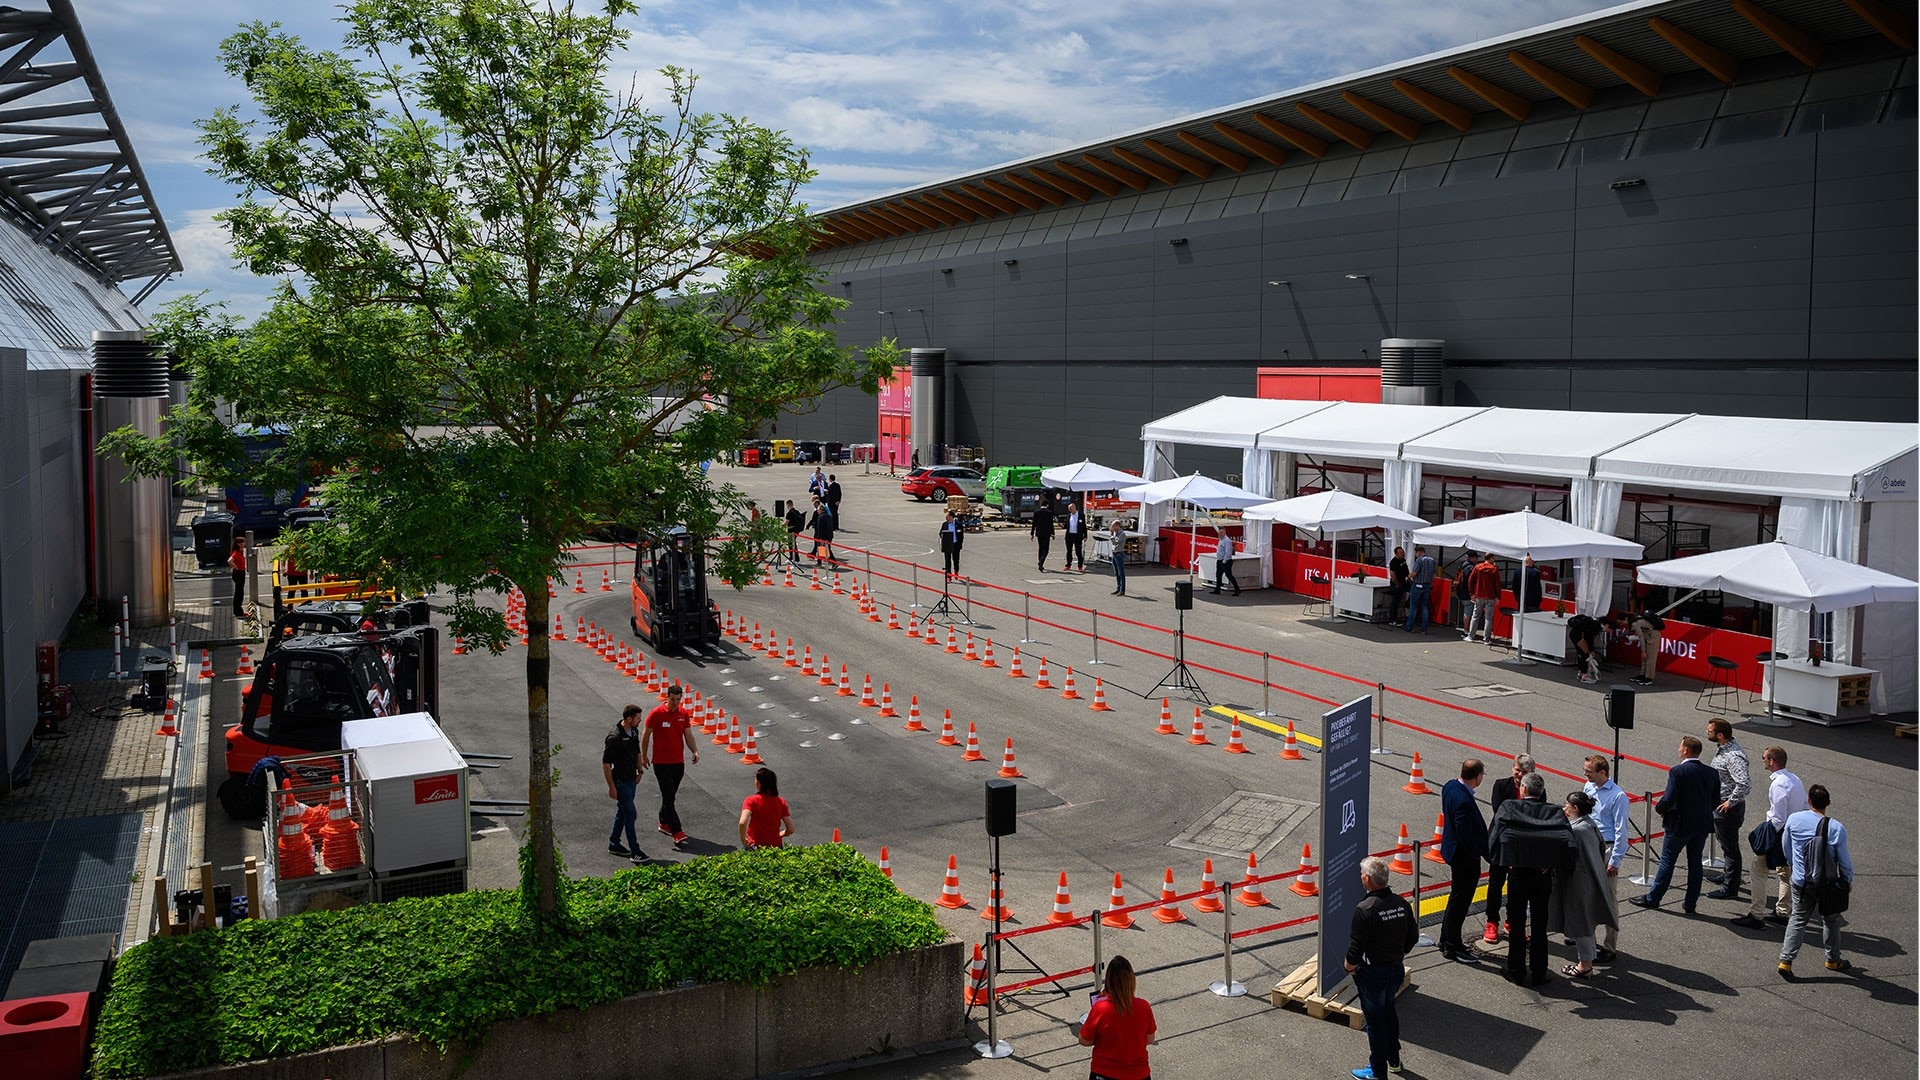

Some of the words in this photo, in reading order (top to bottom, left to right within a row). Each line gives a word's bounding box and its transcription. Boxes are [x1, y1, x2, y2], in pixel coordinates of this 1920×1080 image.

[1890, 478, 1906, 487] abele
[1658, 637, 1697, 660] INDE
[1330, 711, 1357, 732] PROBEFAHRT
[422, 788, 456, 801] Linde
